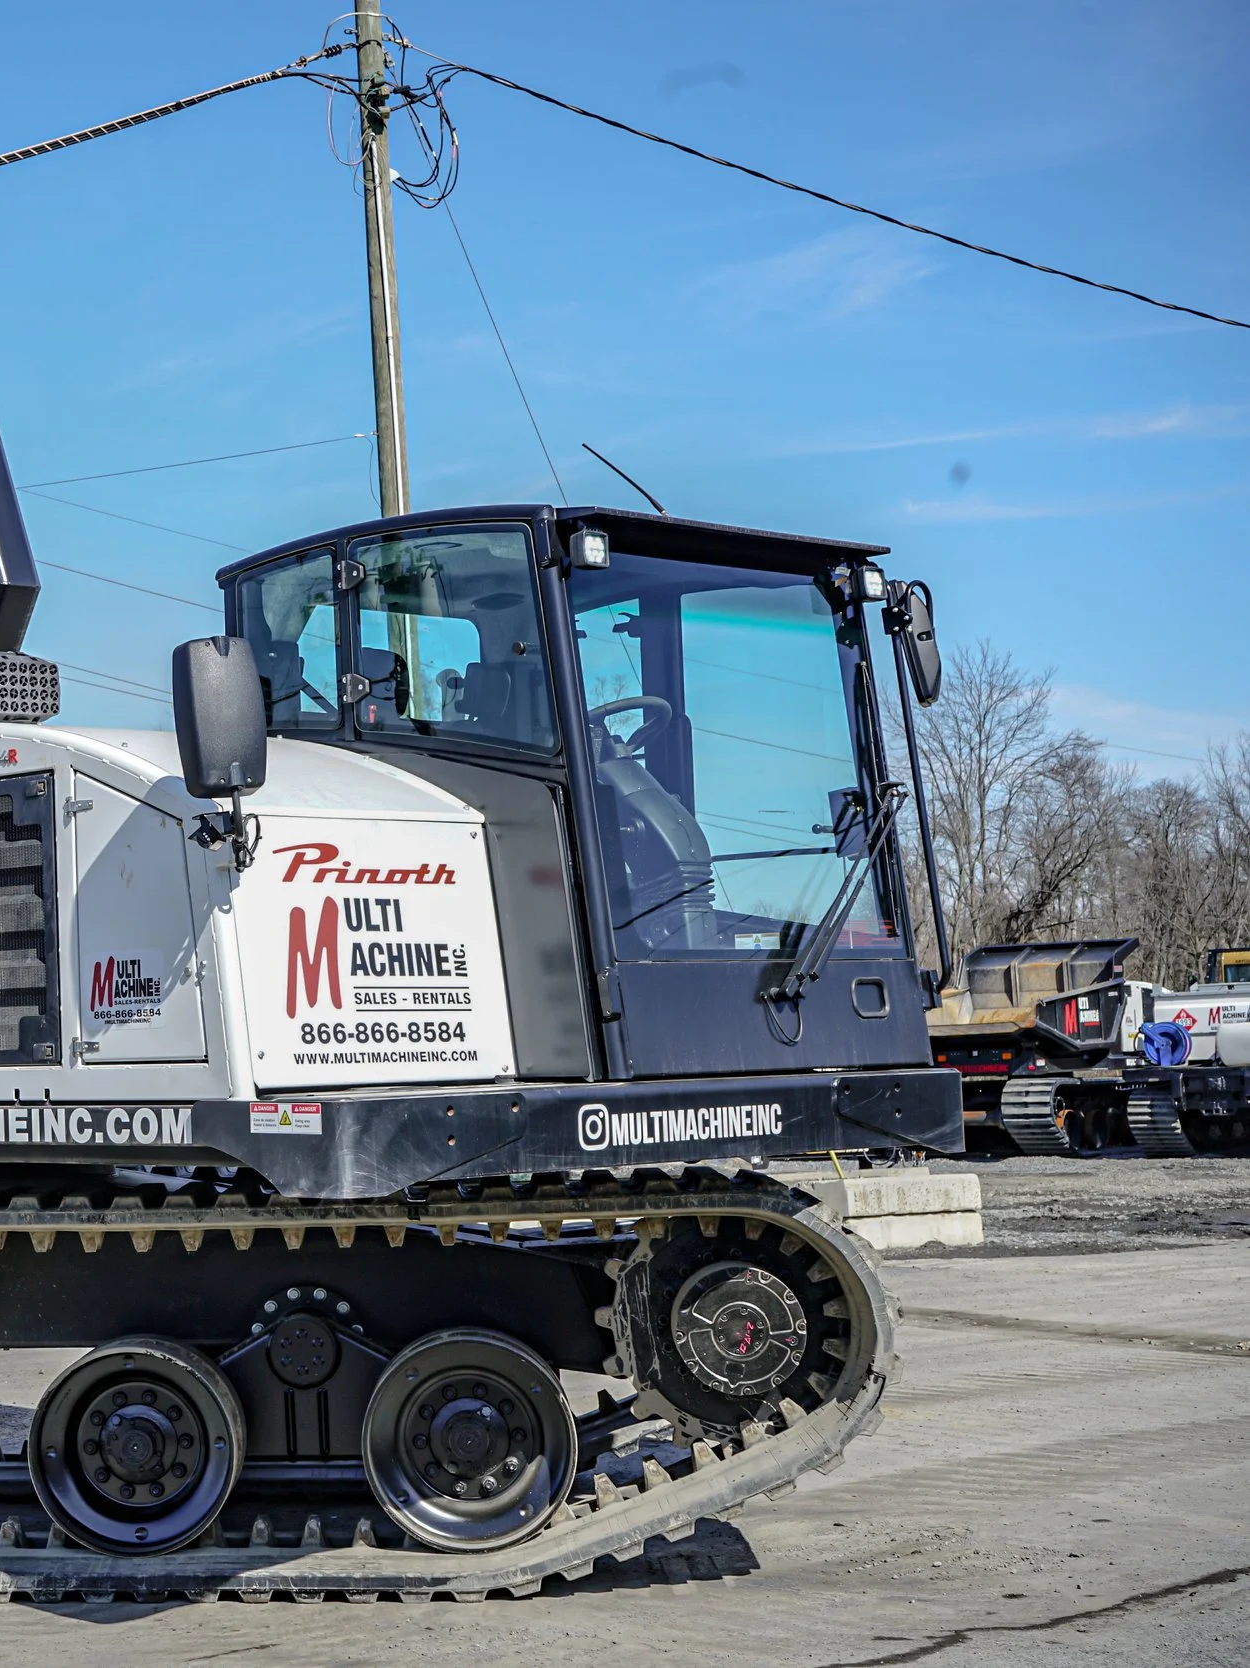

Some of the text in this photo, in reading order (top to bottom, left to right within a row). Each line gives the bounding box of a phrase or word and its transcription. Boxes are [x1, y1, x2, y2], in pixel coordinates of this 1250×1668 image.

[272, 843, 456, 884] Prinoth
[453, 944, 468, 977] INC.
[114, 998, 161, 1006] SALES-RENTALS
[354, 992, 397, 1005] SALES
[413, 992, 471, 1005] RENTALS
[94, 1008, 161, 1019] 866-866-8584
[300, 1021, 466, 1044] 866-866-8584
[294, 1051, 478, 1065] WWW.MULTIMACHINEINC.COM
[611, 1103, 783, 1147] MULTIMACHINEINC
